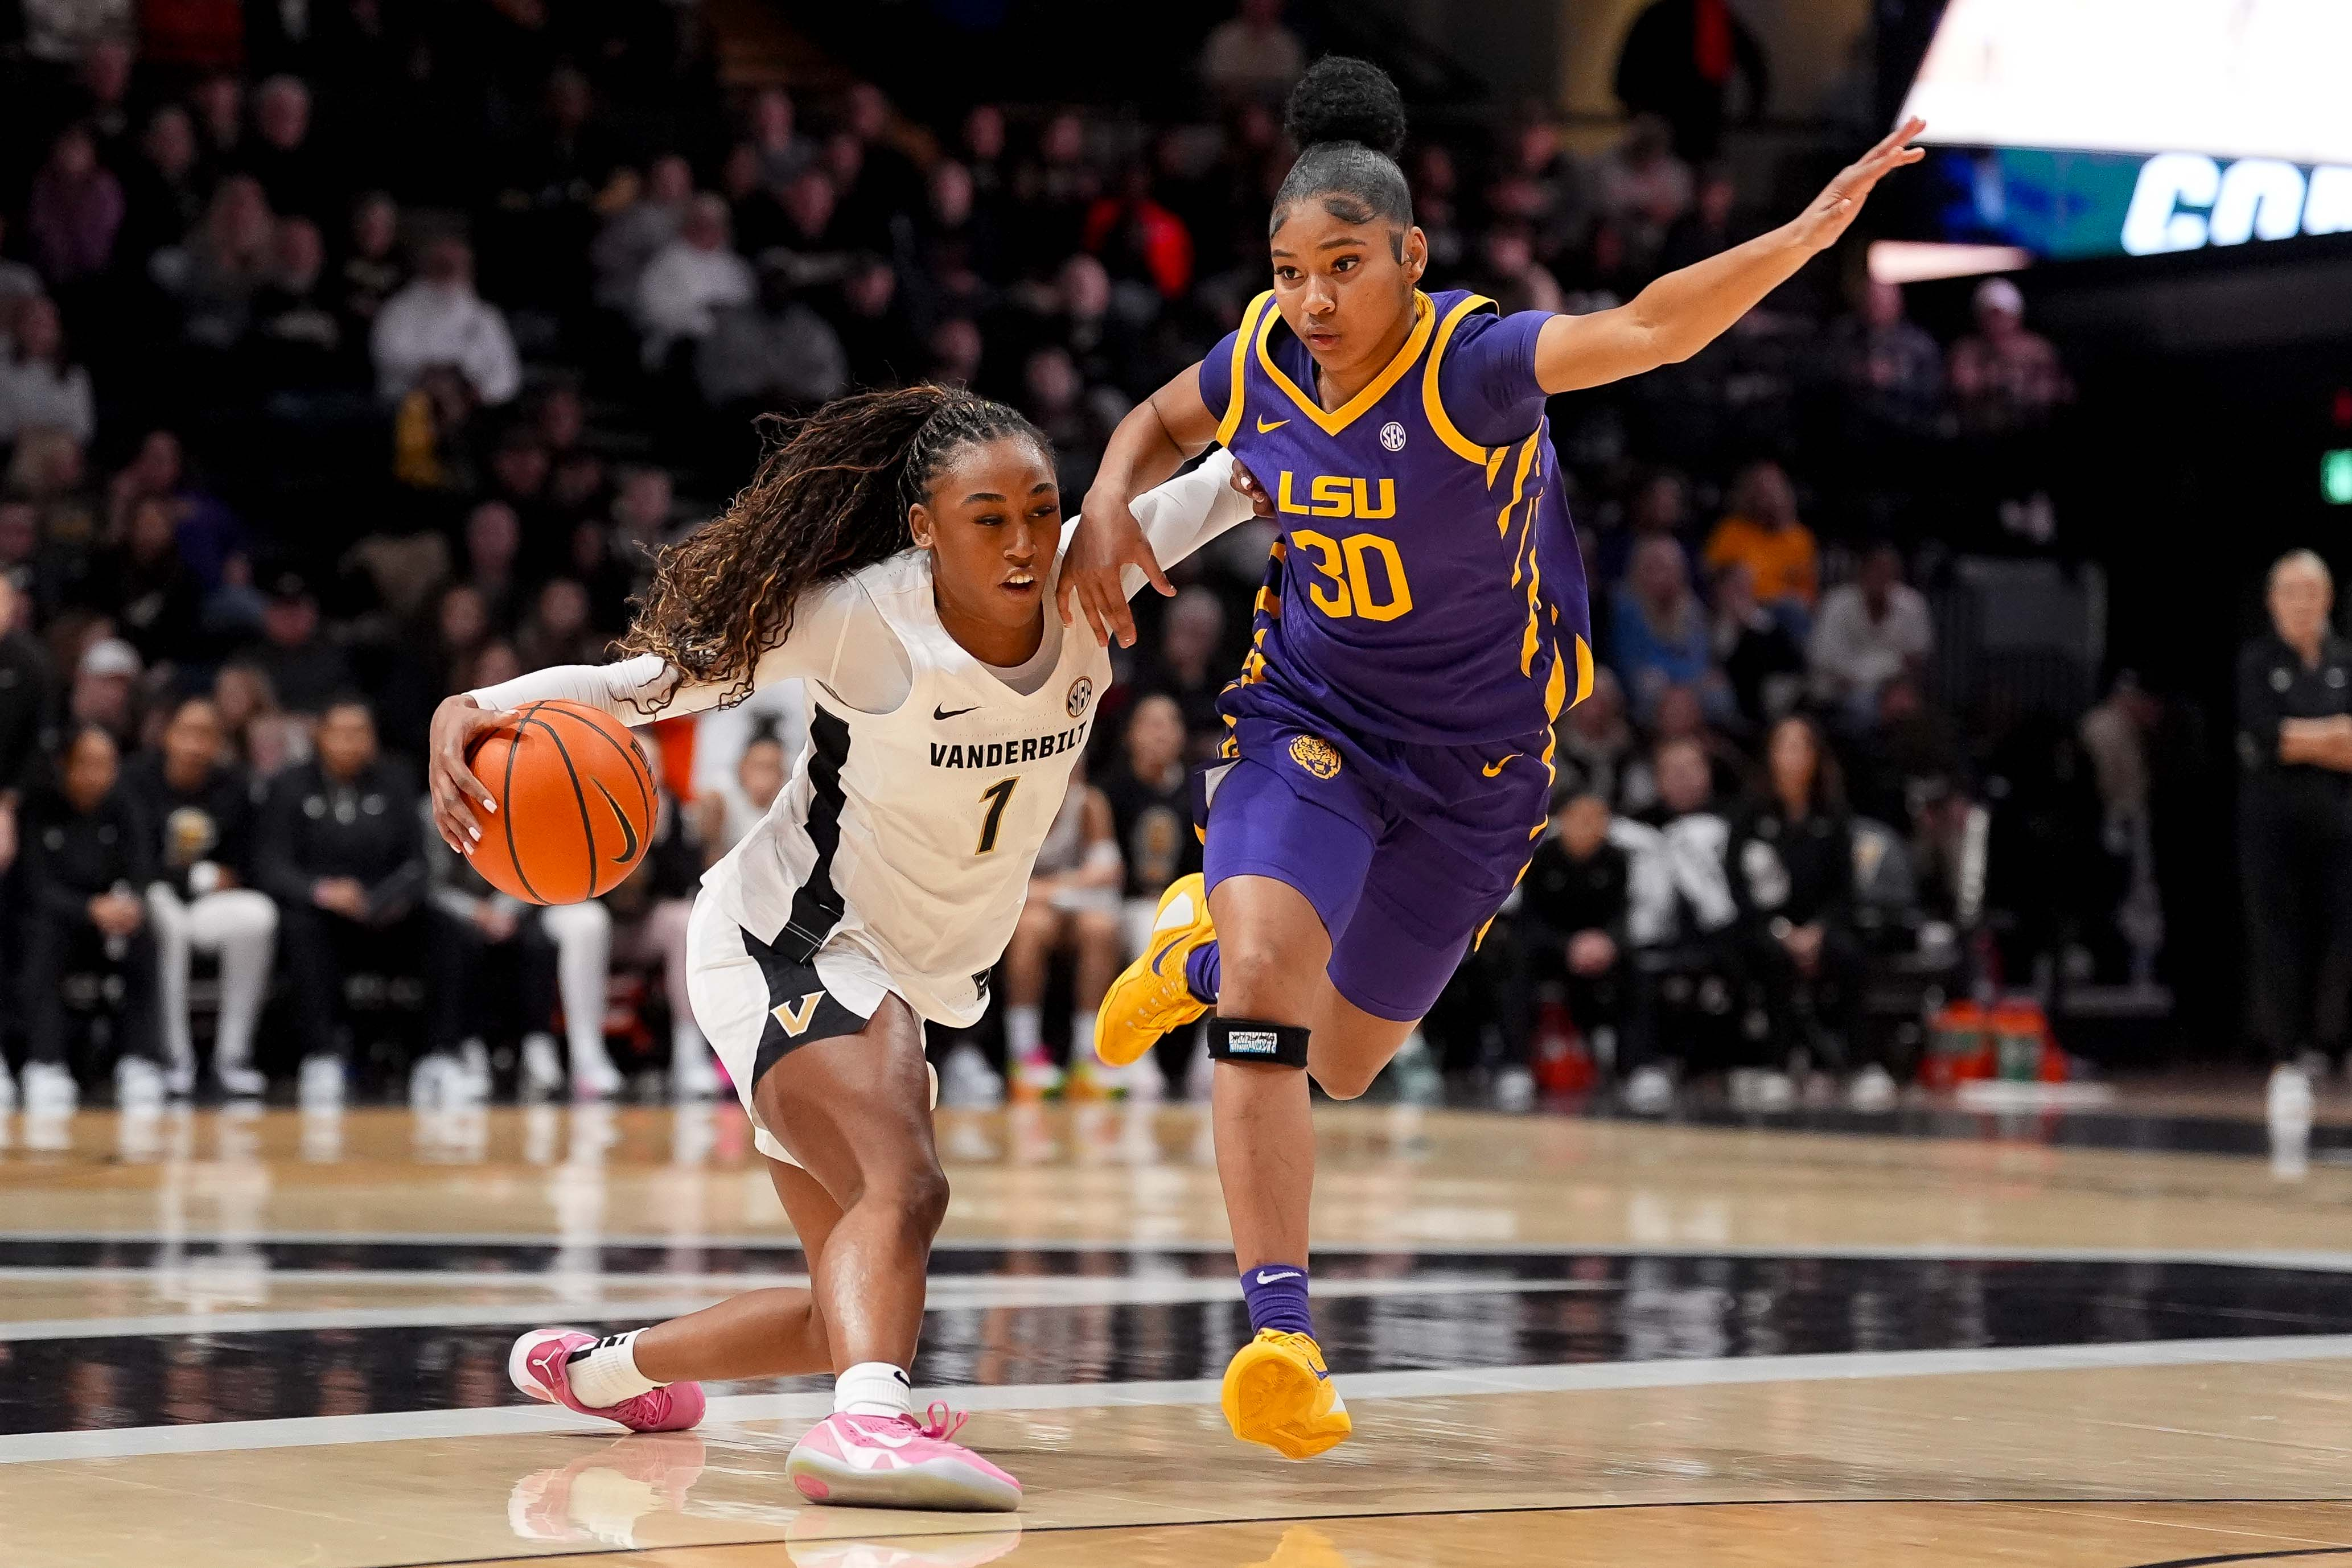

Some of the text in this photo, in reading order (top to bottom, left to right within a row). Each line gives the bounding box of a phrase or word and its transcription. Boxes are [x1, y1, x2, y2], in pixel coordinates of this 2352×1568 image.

[1382, 425, 1404, 448] SEC
[1278, 470, 1396, 518] LSU
[1290, 529, 1413, 622] 30
[1069, 679, 1091, 716] SEC
[930, 720, 1087, 768] VANDERBILT
[974, 776, 1021, 855] 1
[770, 990, 827, 1038] V
